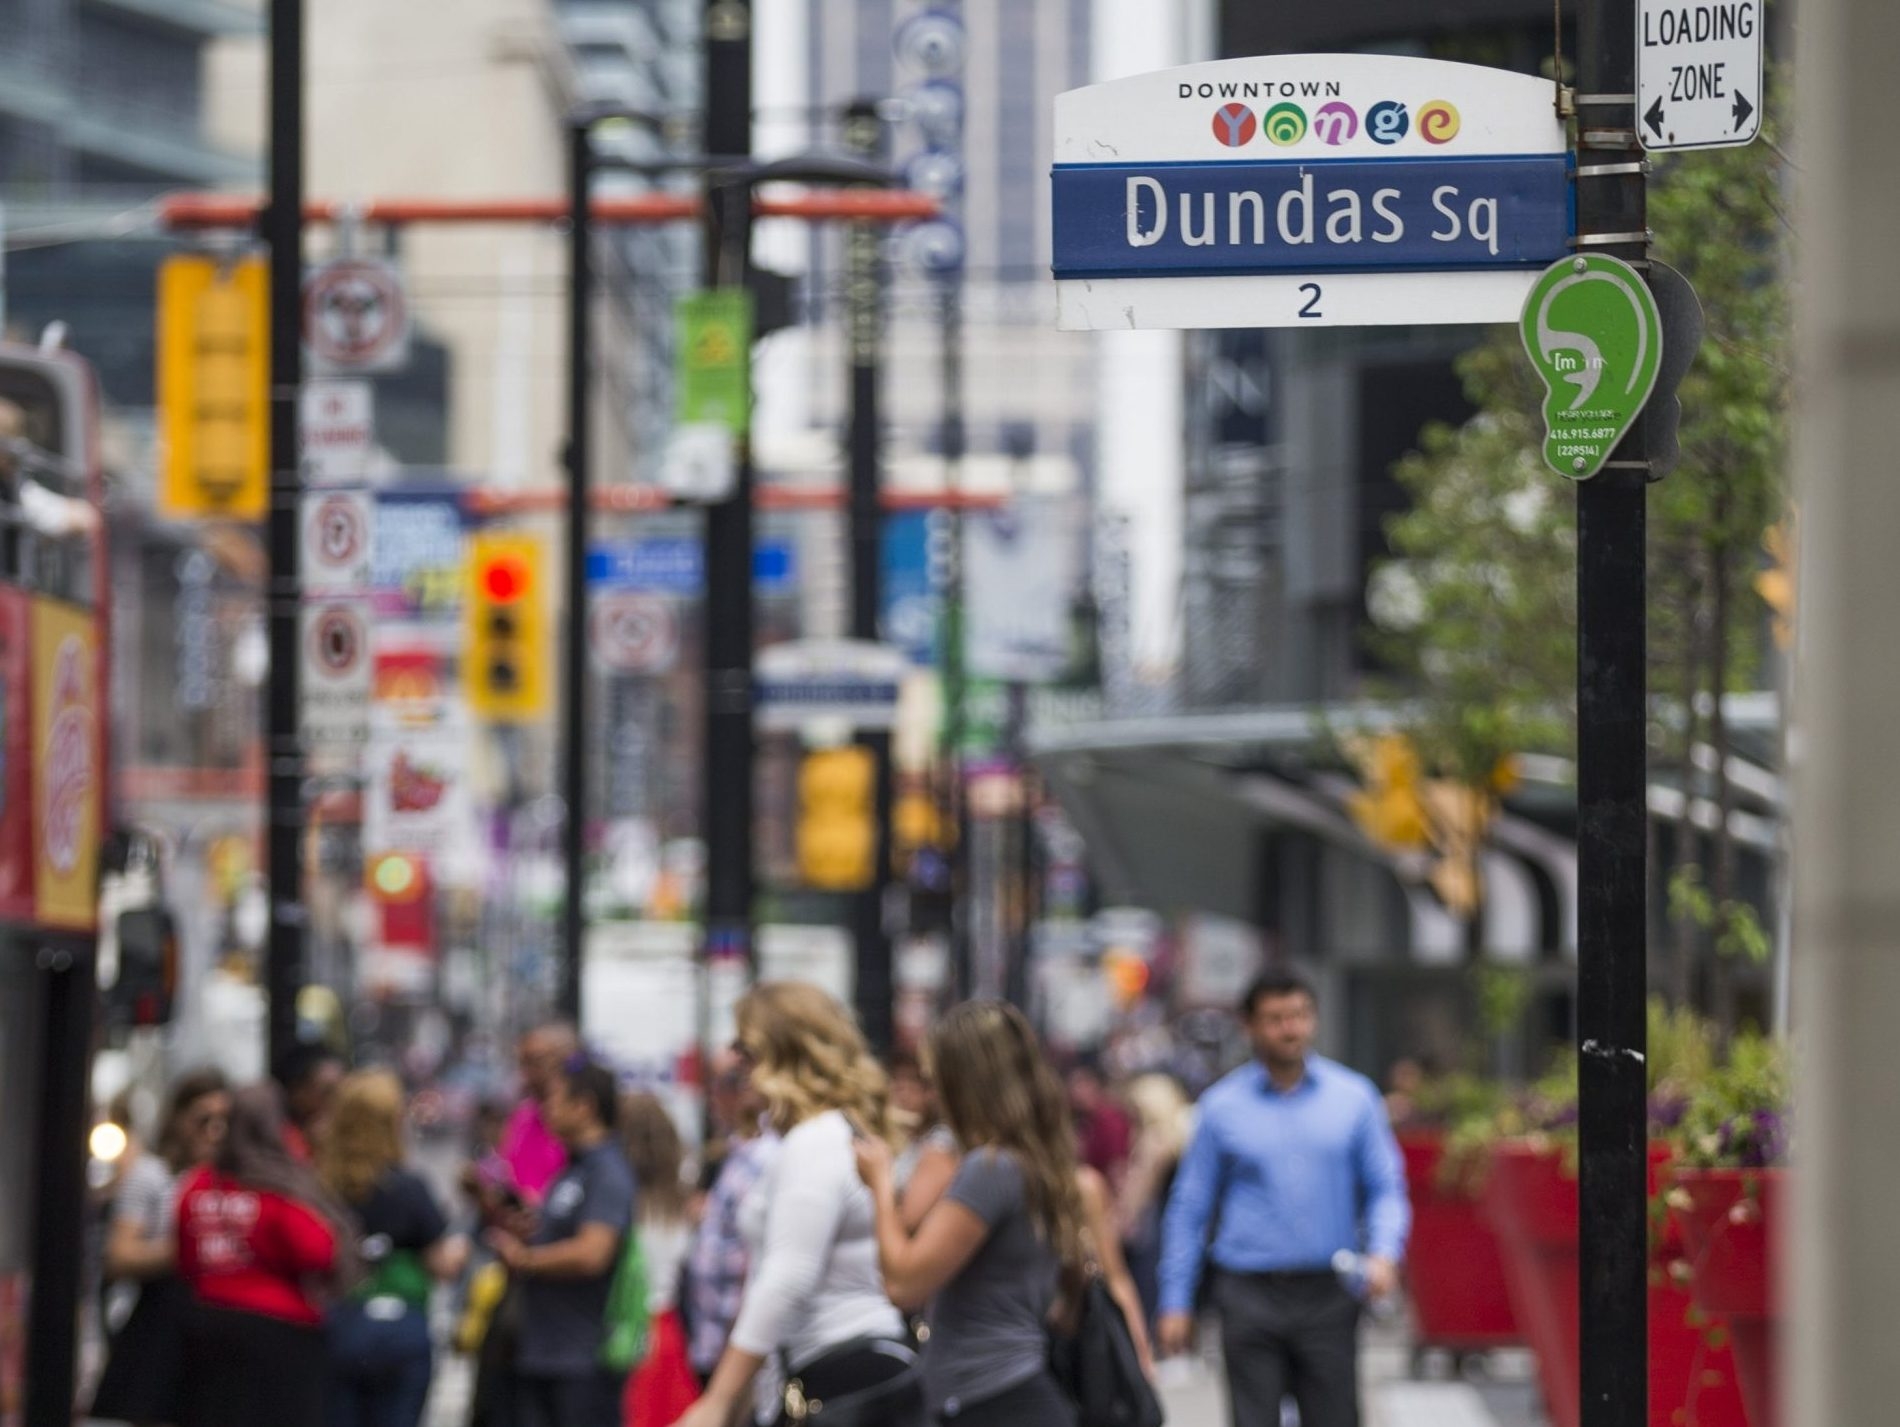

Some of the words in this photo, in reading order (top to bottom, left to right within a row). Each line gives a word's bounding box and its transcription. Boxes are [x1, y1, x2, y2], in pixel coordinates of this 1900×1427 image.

[1644, 2, 1753, 47] LOADING
[1178, 81, 1341, 99] DOWNTOWN
[1670, 62, 1726, 102] ZONE
[1125, 173, 1405, 248] Dundas
[1431, 185, 1499, 256] Sq
[1298, 282, 1323, 318] 2
